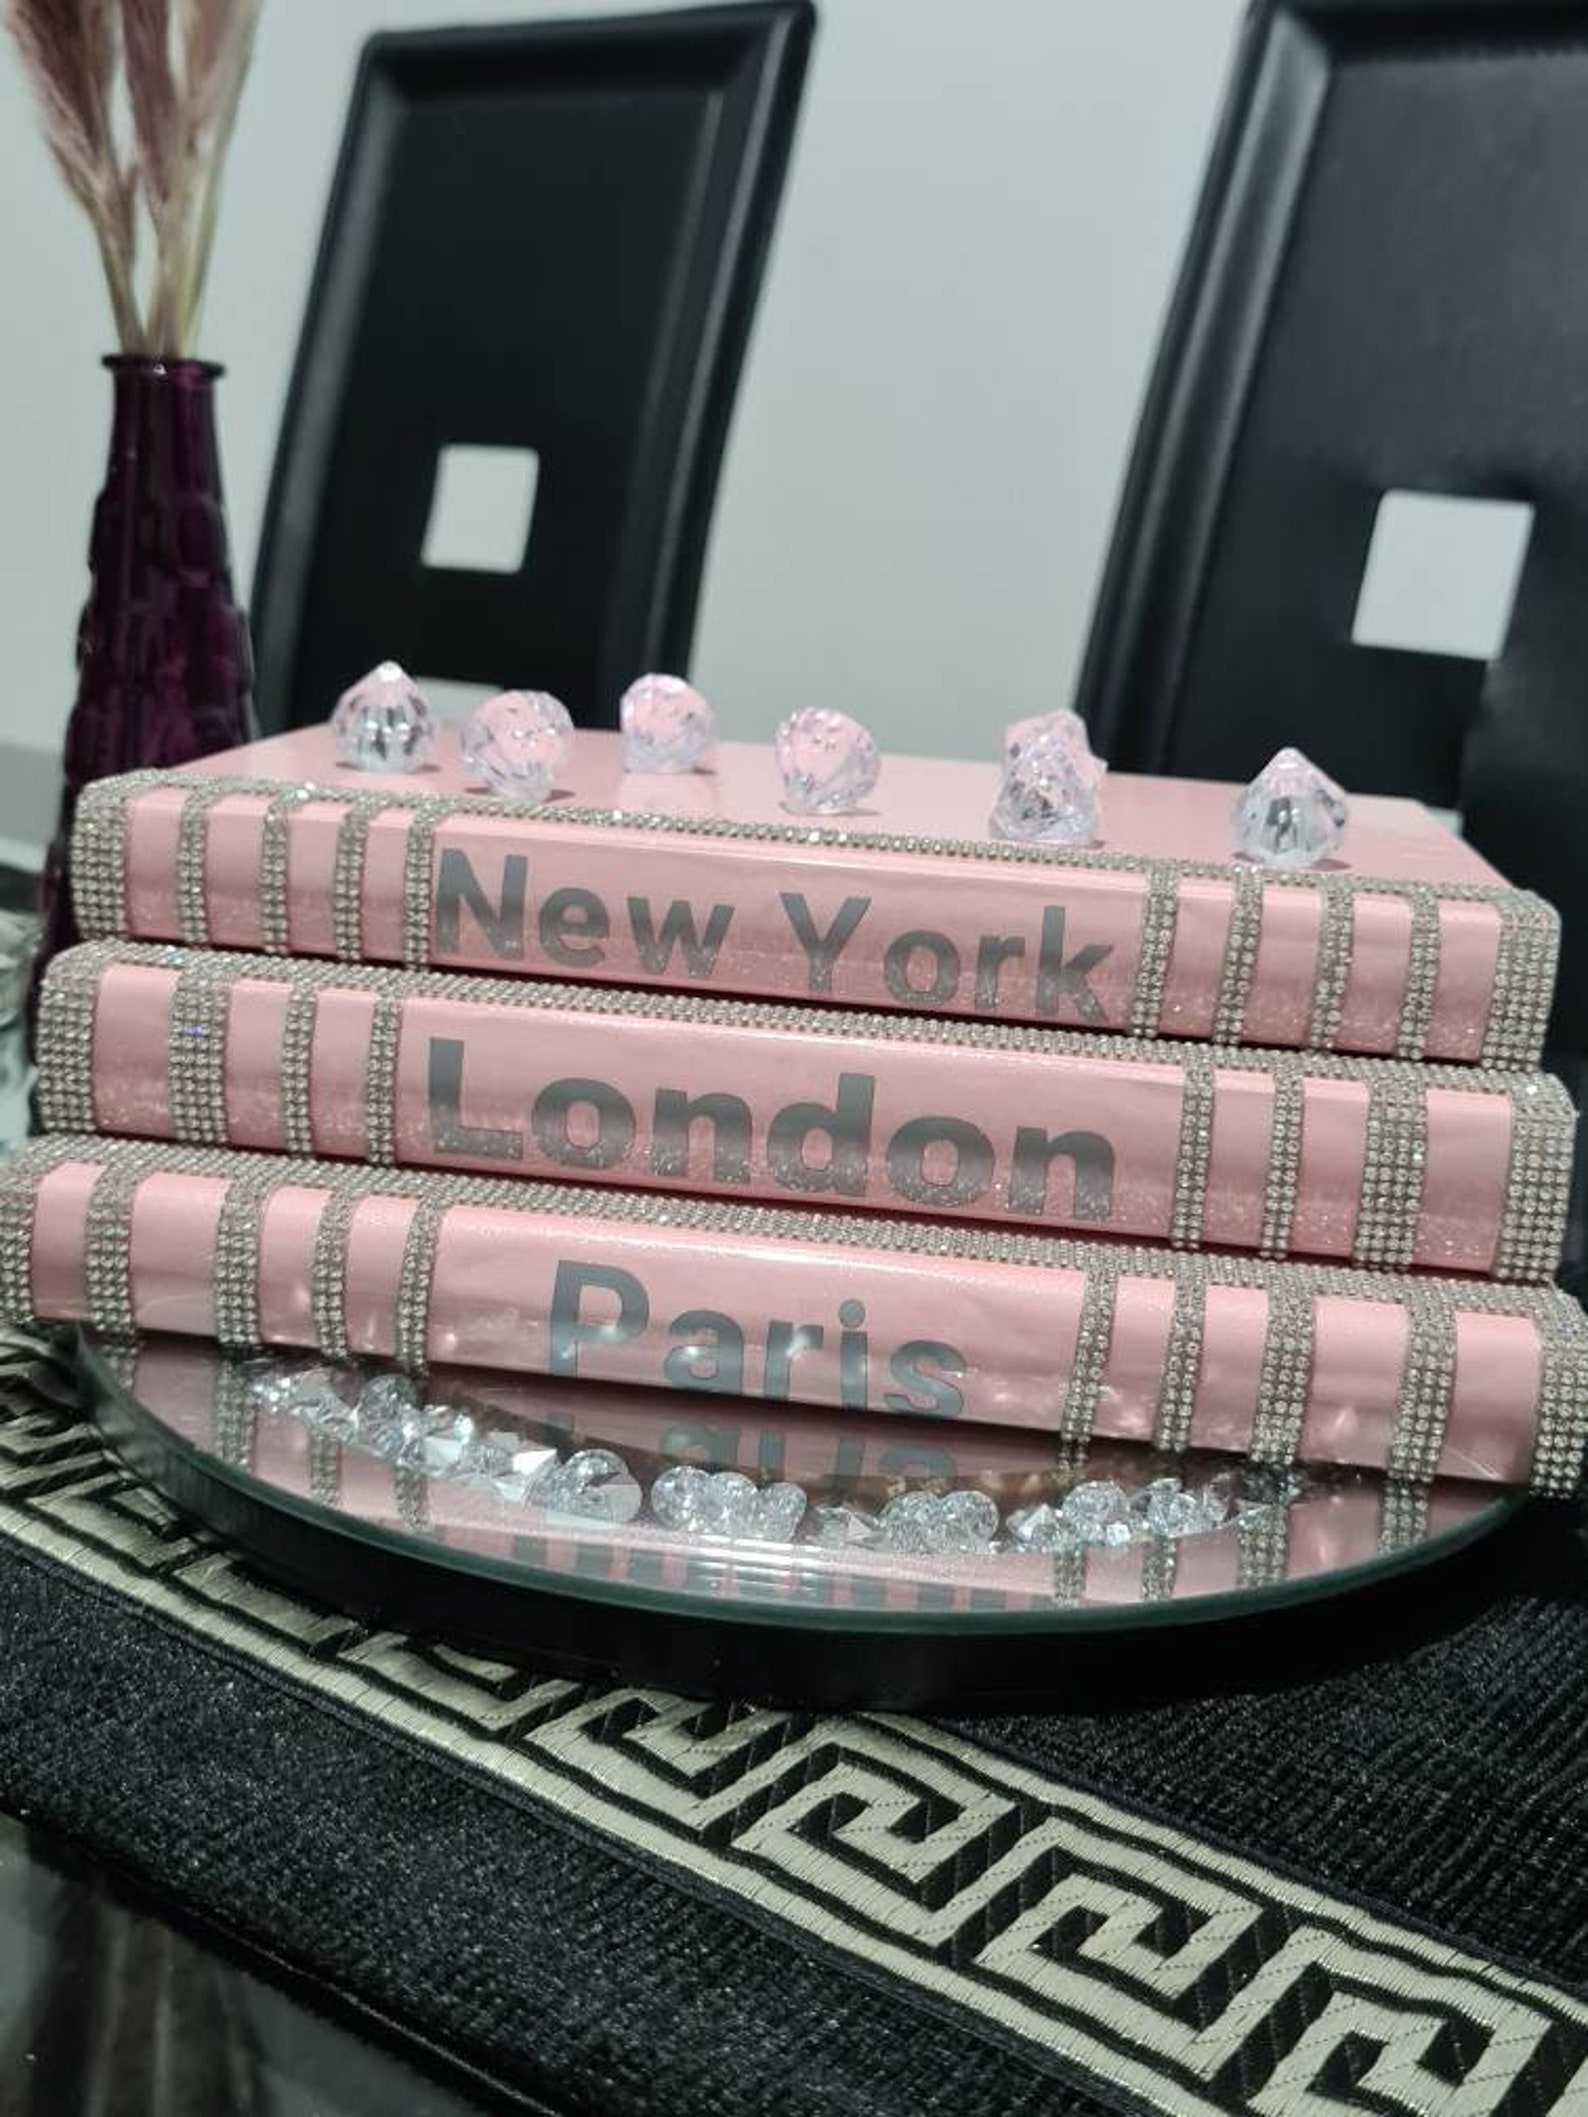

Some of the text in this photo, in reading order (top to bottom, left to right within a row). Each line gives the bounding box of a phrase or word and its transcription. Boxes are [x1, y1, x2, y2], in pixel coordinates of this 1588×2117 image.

[434, 847, 1114, 1022] New York
[428, 1036, 1116, 1221] London
[548, 1259, 967, 1420] Paris
